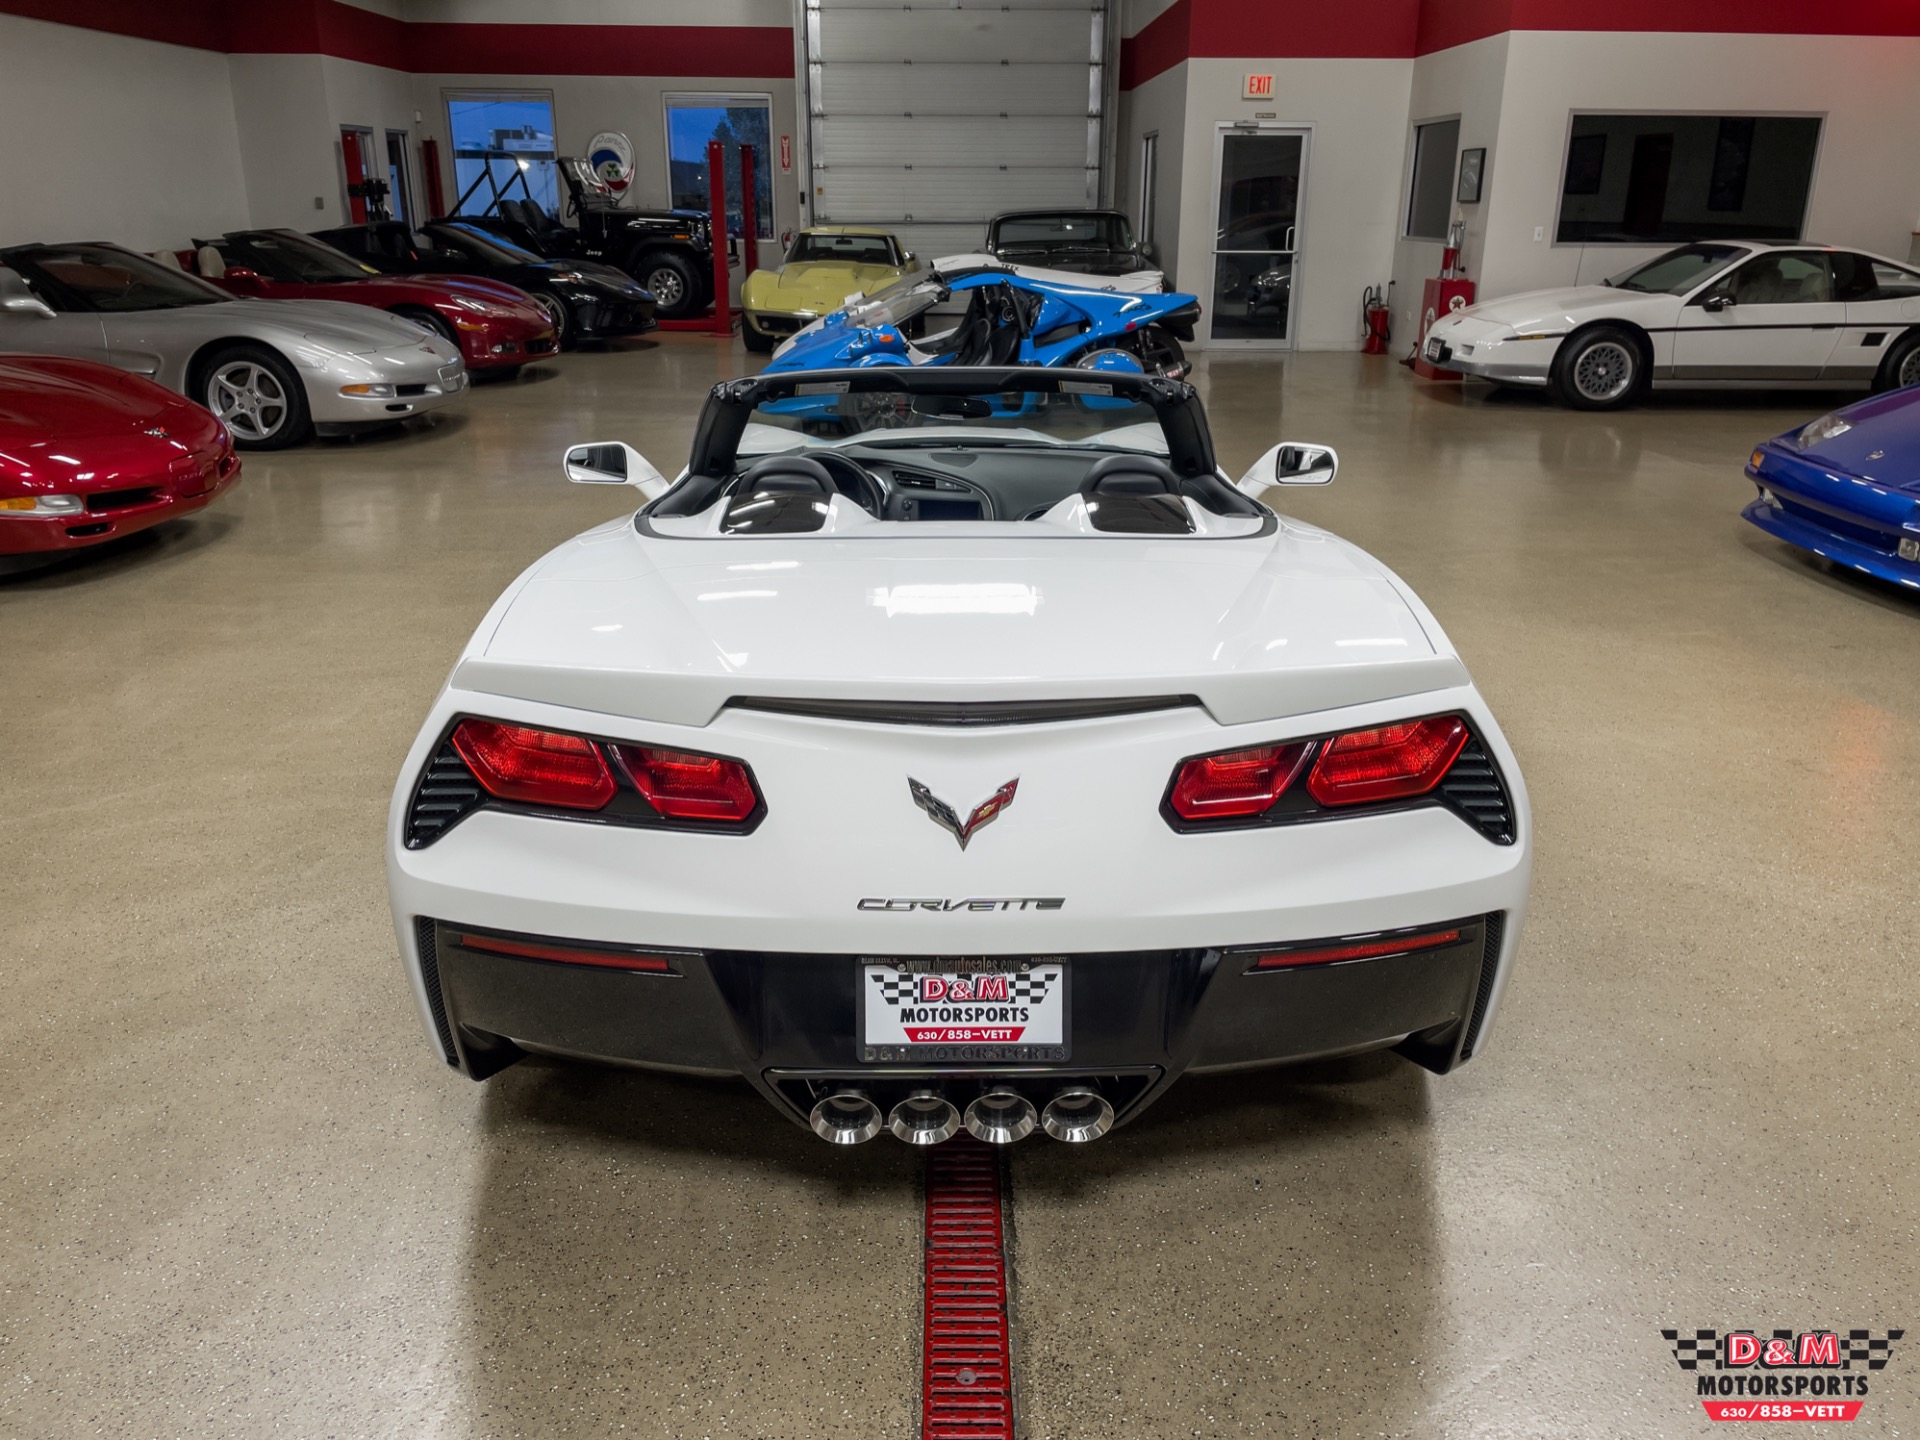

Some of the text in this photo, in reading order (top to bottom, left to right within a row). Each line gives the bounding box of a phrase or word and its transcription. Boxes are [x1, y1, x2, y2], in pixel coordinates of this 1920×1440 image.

[1249, 75, 1272, 94] EXIT
[586, 249, 602, 257] Jeep
[857, 898, 1065, 911] CORVETTE
[921, 976, 1009, 1002] D&M
[900, 1007, 1029, 1023] MOTORSPORTS
[919, 1045, 1066, 1061] MOTORSPORTS
